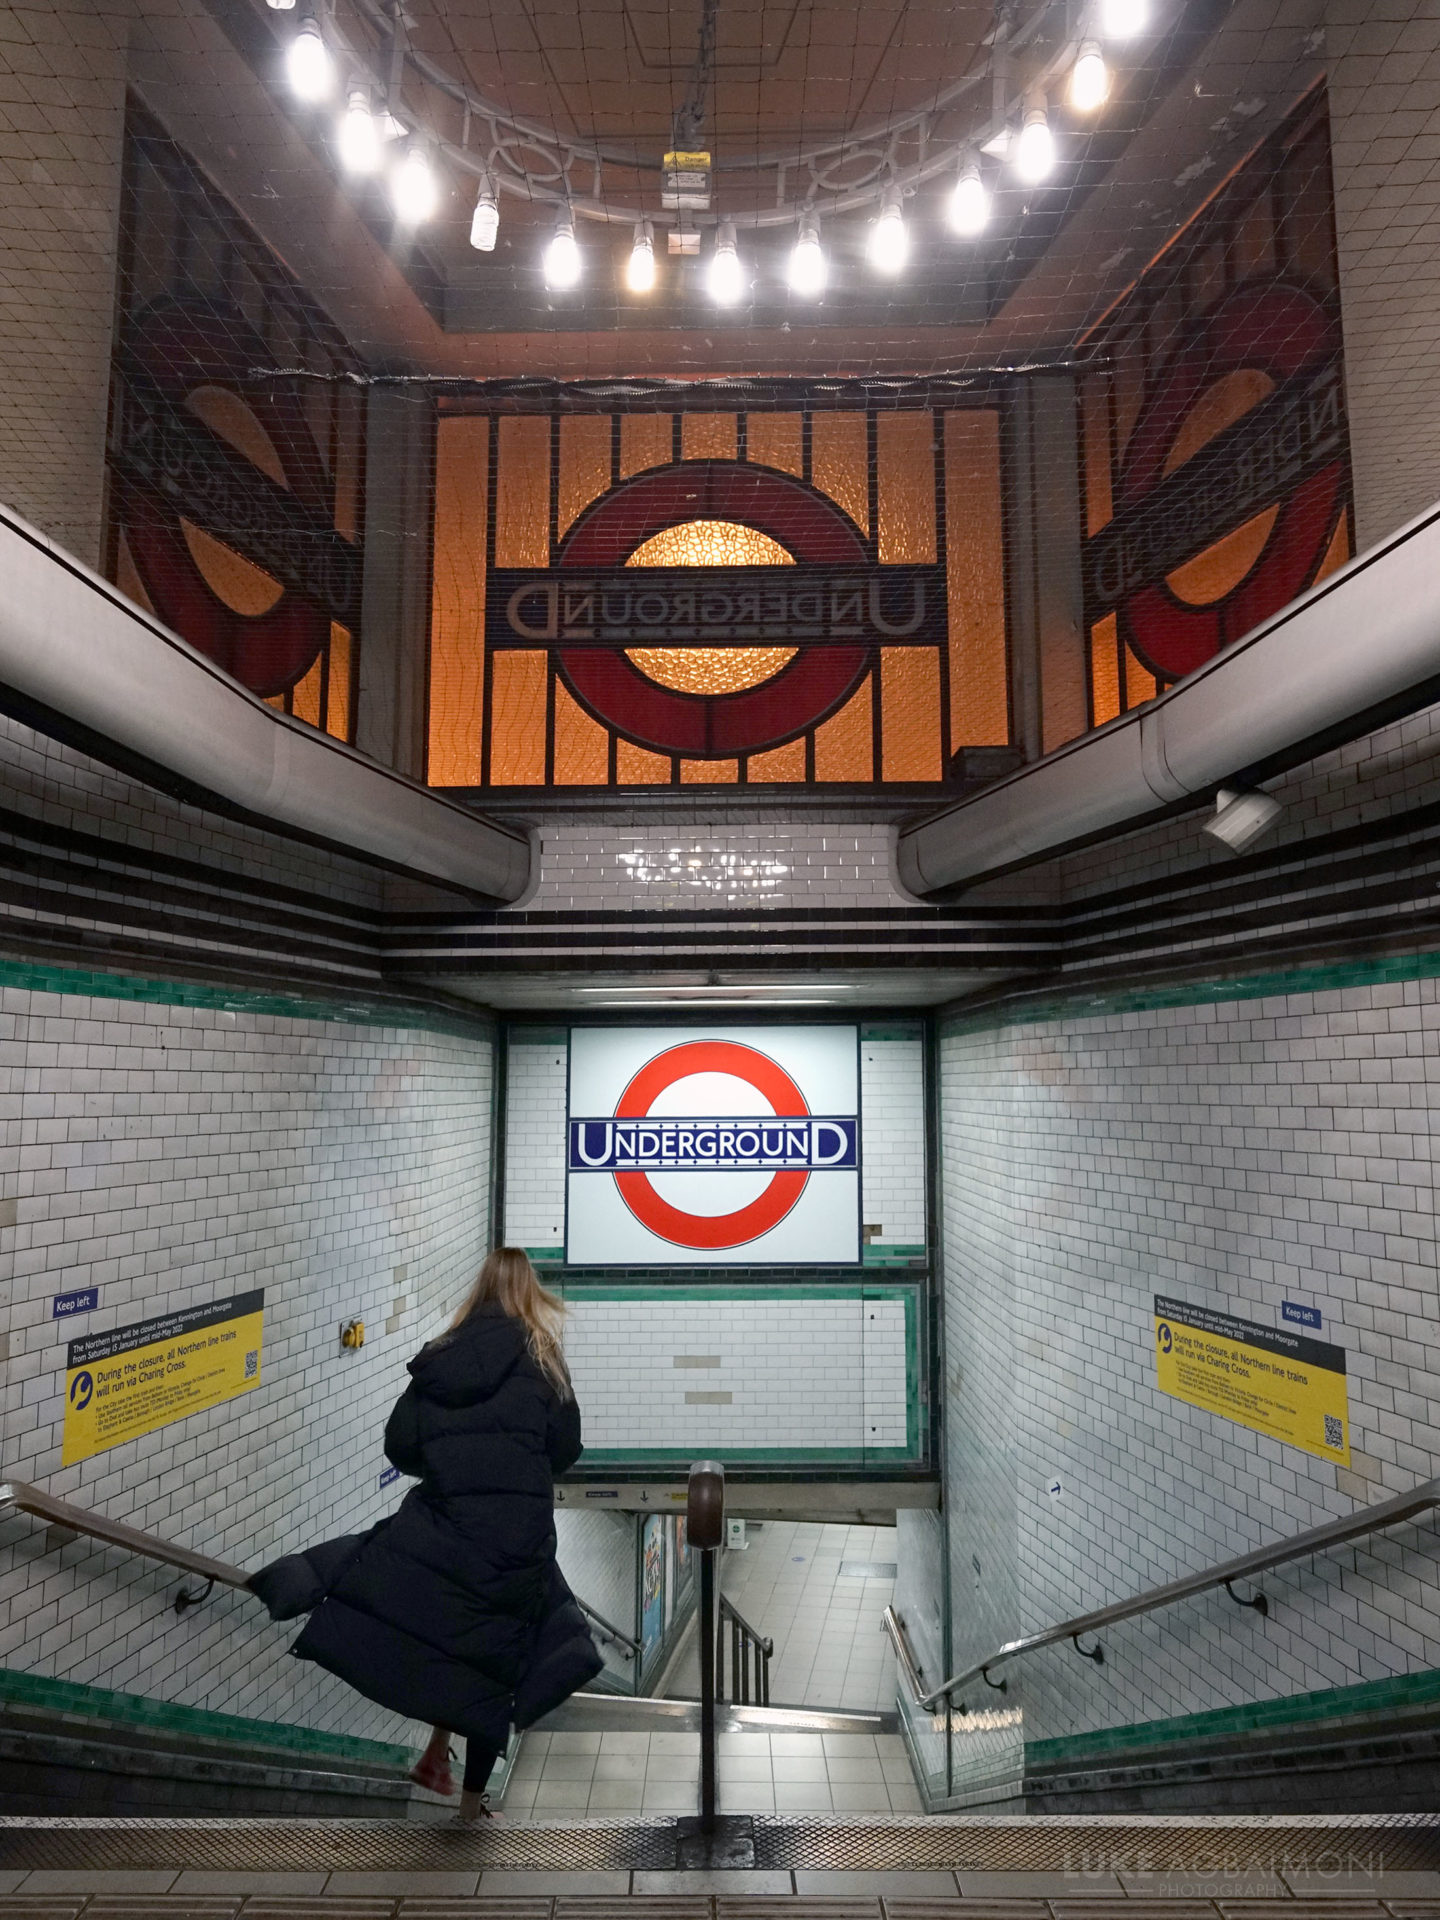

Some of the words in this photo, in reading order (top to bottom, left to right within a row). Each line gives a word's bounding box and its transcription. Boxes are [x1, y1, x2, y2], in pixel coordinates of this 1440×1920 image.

[578, 1122, 848, 1166] UNDERGROUND
[56, 1301, 75, 1312] Keep
[77, 1296, 90, 1307] left
[1285, 1306, 1301, 1320] Keep
[1302, 1310, 1315, 1322] left
[72, 1344, 83, 1354] The
[85, 1337, 110, 1350] Northern
[111, 1334, 121, 1342] line
[122, 1329, 131, 1339] will
[132, 1328, 139, 1336] be
[140, 1322, 156, 1334] closed
[157, 1318, 176, 1329] between
[178, 1311, 202, 1323] Kennington
[203, 1307, 211, 1316] and
[212, 1302, 231, 1313] Moorgate
[72, 1355, 85, 1364] from
[87, 1347, 110, 1359] Saturday
[112, 1343, 117, 1352] 15
[118, 1339, 137, 1350] January
[138, 1334, 150, 1344] until
[151, 1329, 171, 1340] mid-May
[172, 1324, 182, 1333] 2022
[1188, 1316, 1203, 1328] January
[1214, 1326, 1232, 1336] mid-May
[1205, 1313, 1218, 1323] closed
[1219, 1316, 1237, 1329] between
[1238, 1322, 1263, 1336] Kennington
[1264, 1331, 1274, 1340] and
[1275, 1333, 1298, 1346] Moorgate
[96, 1368, 121, 1383] During
[124, 1362, 136, 1374] the
[138, 1354, 165, 1370] closure,
[177, 1341, 206, 1357] Northern
[207, 1337, 218, 1346] line
[220, 1331, 236, 1343] trains
[1174, 1331, 1192, 1347] During
[1193, 1338, 1203, 1349] the
[1205, 1343, 1229, 1359] closure,
[1230, 1351, 1238, 1361] all
[1240, 1353, 1270, 1373] Northern
[1272, 1364, 1284, 1377] line
[1287, 1369, 1307, 1385] trains
[1174, 1345, 1183, 1355] will
[1185, 1351, 1194, 1359] run
[1197, 1354, 1205, 1362] via
[1206, 1354, 1229, 1372] Charing
[1231, 1362, 1250, 1378] Cross.
[96, 1383, 109, 1398] will
[112, 1383, 124, 1393] run
[127, 1378, 136, 1387] via
[138, 1368, 164, 1383] Charing
[166, 1361, 185, 1374] Cross.
